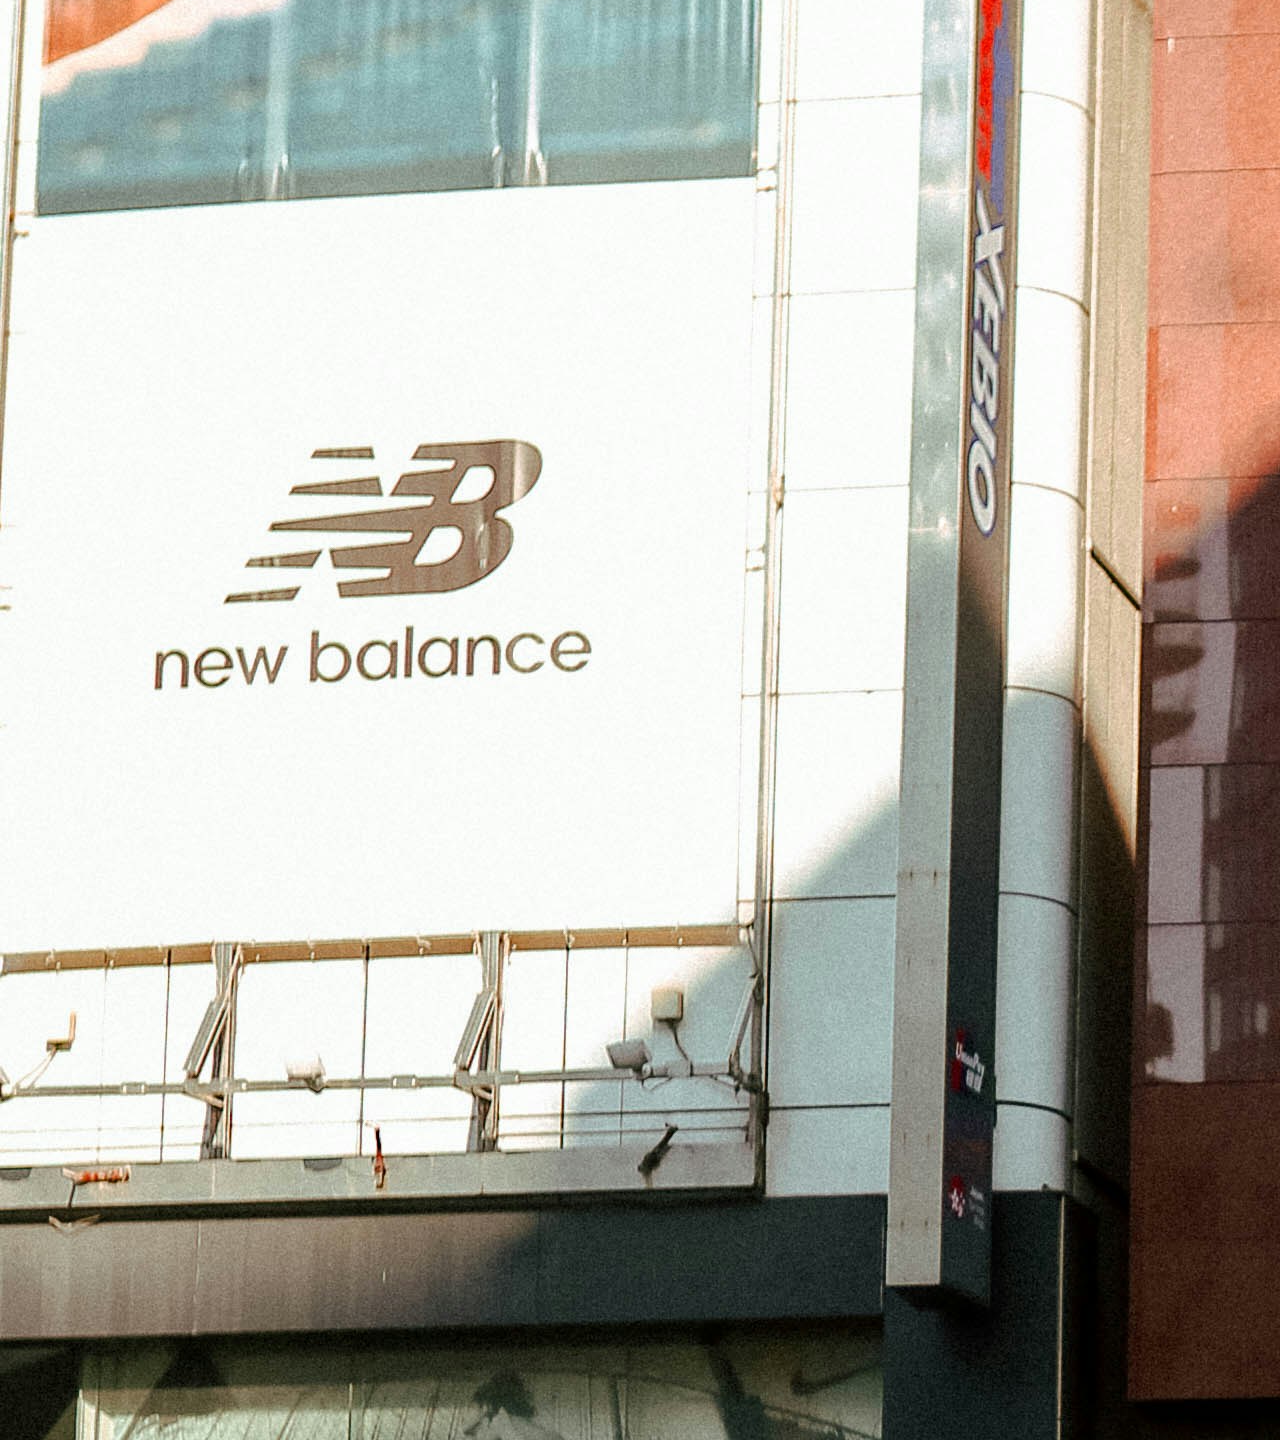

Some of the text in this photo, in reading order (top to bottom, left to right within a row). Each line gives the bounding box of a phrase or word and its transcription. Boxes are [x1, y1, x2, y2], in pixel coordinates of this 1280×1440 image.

[967, 186, 1007, 536] XEBIO
[154, 625, 592, 690] new balance
